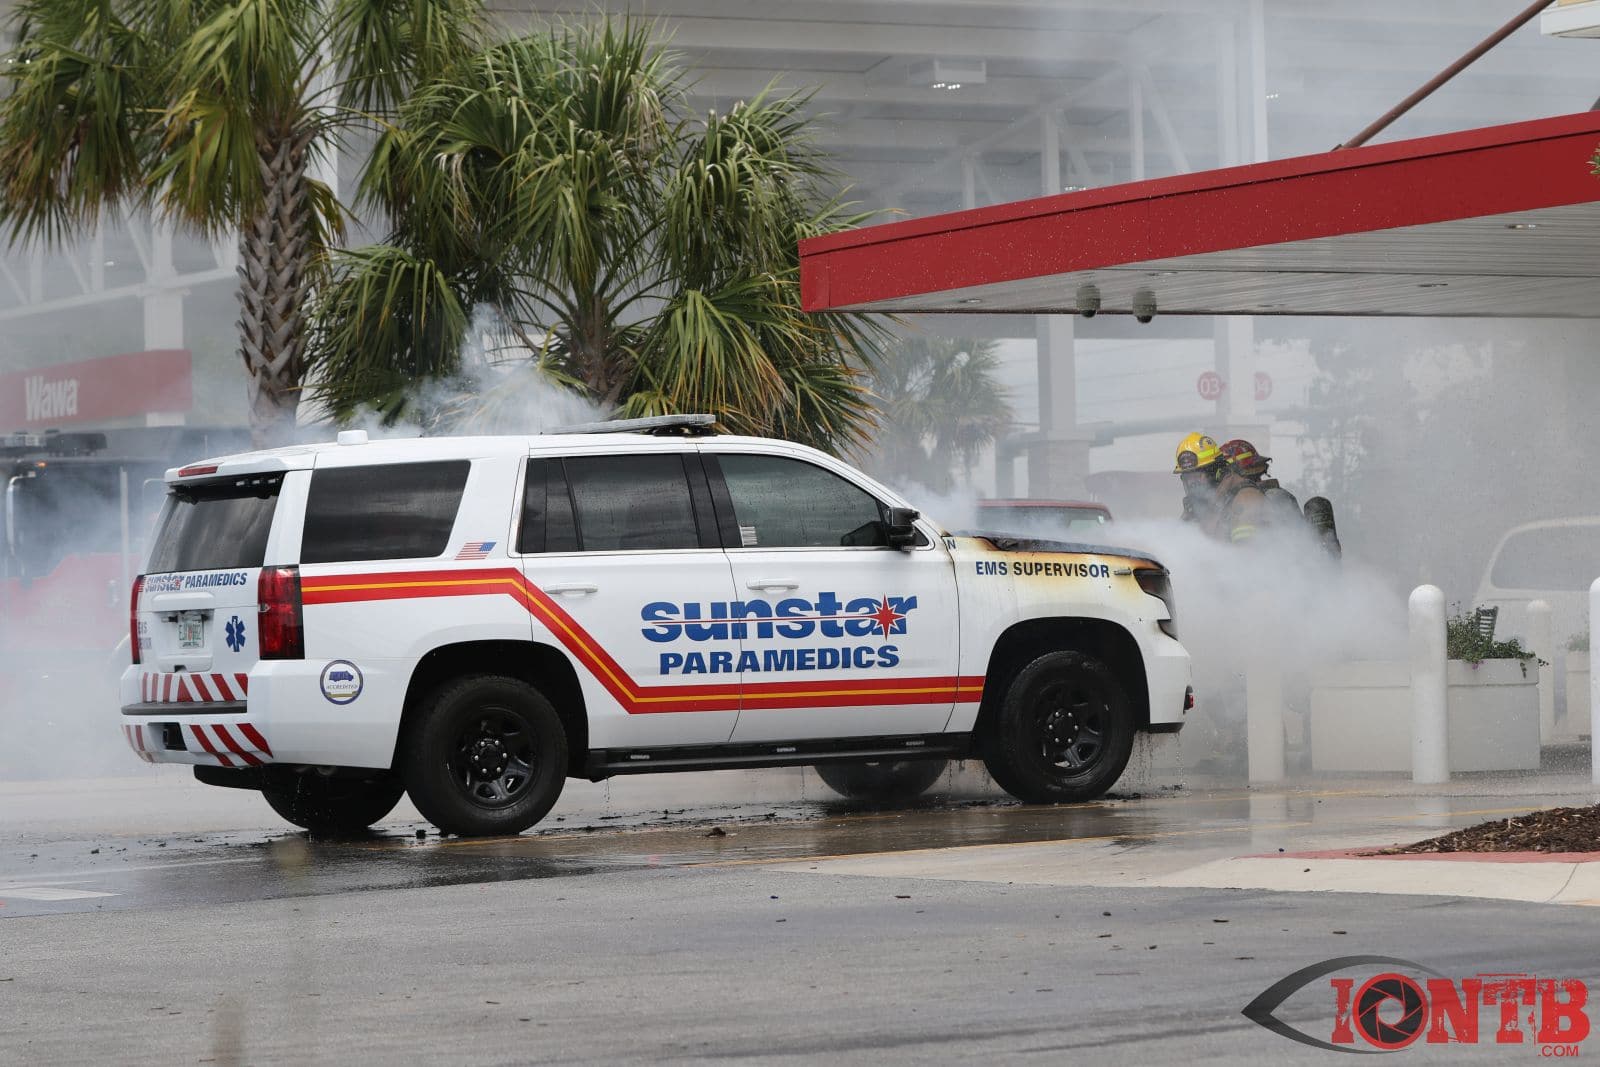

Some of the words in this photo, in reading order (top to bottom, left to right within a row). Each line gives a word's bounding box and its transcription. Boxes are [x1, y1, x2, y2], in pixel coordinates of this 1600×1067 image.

[1200, 378, 1220, 394] 03
[24, 375, 78, 421] Wawa
[185, 572, 248, 589] PARAMEDICS
[975, 561, 1008, 575] EMS
[1013, 561, 1110, 578] SUPERVISOR
[641, 591, 918, 643] sunstar
[660, 645, 900, 675] PARAMEDICS
